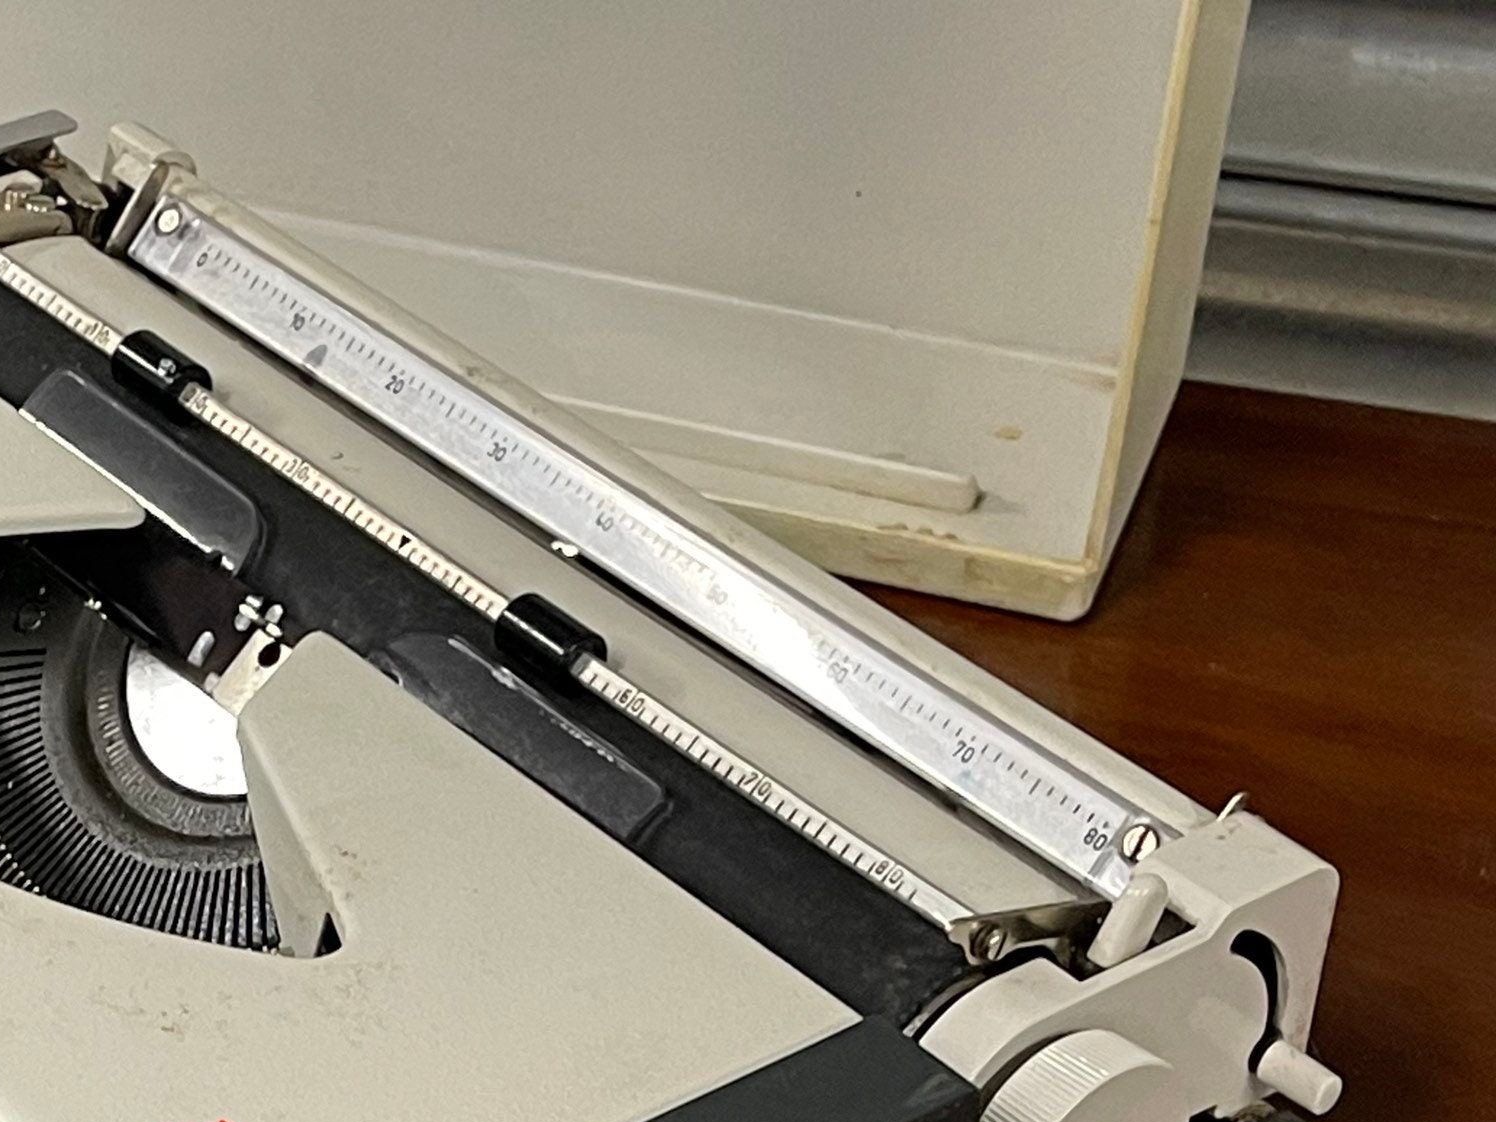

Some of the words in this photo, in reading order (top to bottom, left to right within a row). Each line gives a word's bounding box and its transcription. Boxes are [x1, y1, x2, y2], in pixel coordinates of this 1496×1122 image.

[385, 375, 404, 394] 20
[487, 442, 507, 462] 30
[827, 663, 849, 683] 60
[953, 741, 975, 764] 70
[1084, 828, 1106, 851] 80
[619, 689, 644, 712] 60
[745, 773, 771, 795] 70
[876, 862, 902, 884] 80
